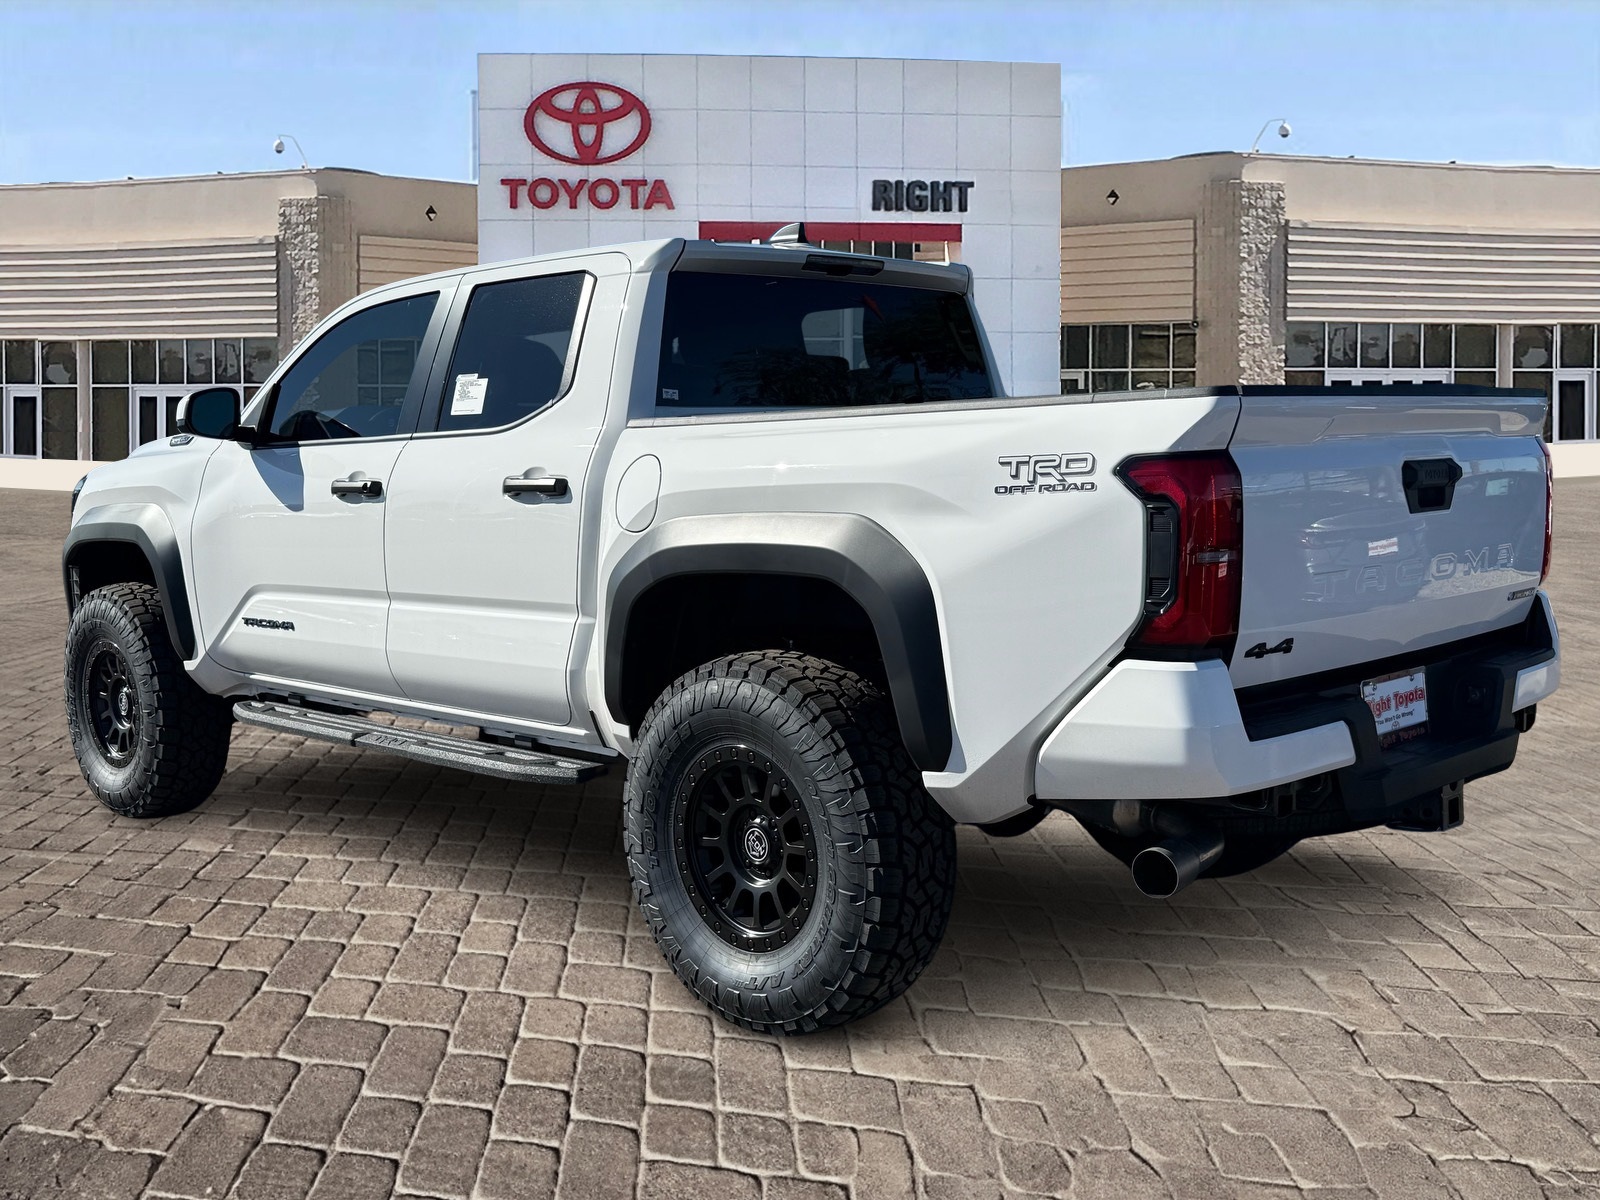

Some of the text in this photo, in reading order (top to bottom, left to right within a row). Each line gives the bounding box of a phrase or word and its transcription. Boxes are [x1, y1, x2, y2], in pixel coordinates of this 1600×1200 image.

[500, 177, 675, 210] TOYOTA
[872, 179, 975, 212] RIGHT
[998, 452, 1097, 485] TRD
[994, 481, 1097, 496] OFF ROAD
[242, 617, 295, 632] TACOMA
[1393, 685, 1425, 711] Toyota
